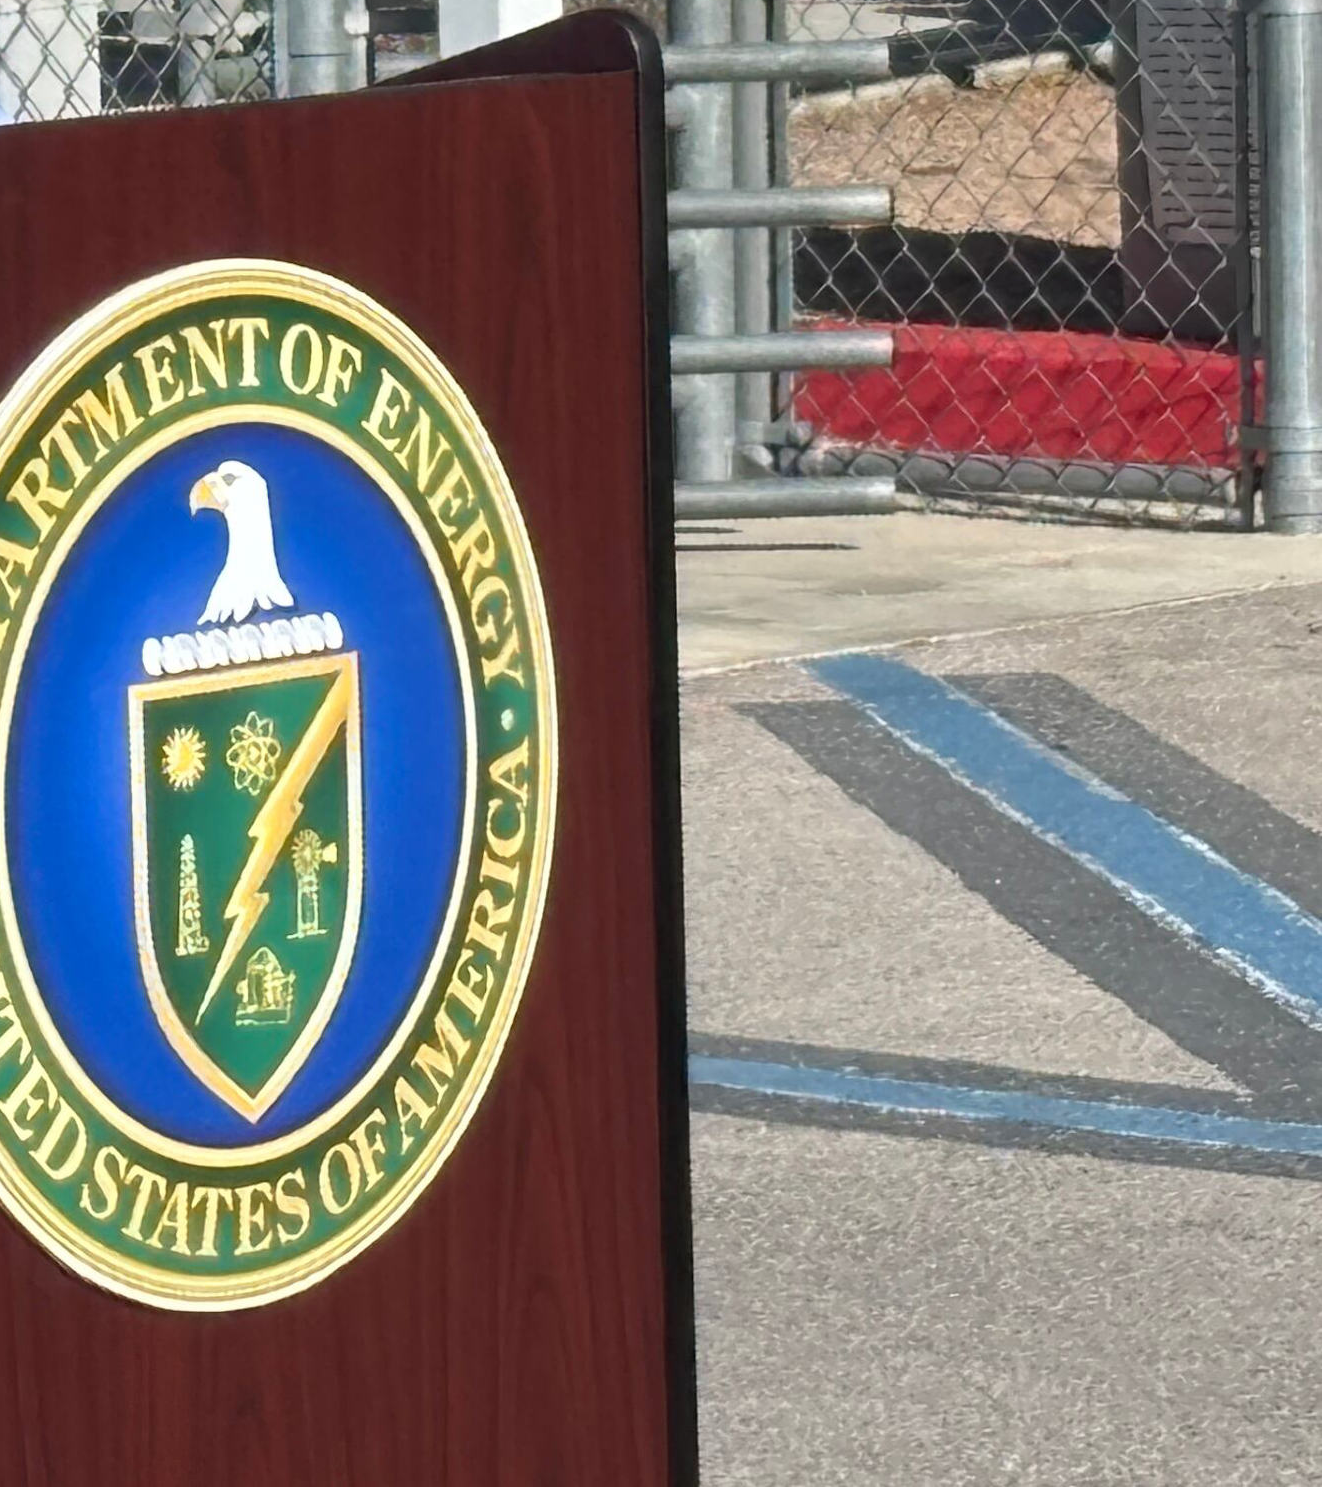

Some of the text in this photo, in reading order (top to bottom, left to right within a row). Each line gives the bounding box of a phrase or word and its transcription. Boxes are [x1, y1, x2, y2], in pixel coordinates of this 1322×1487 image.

[278, 322, 365, 407] OF
[361, 367, 525, 694] ENERGY
[79, 1144, 313, 1259] STATES
[318, 1109, 389, 1219] OF
[385, 734, 531, 1158] AMERICA
